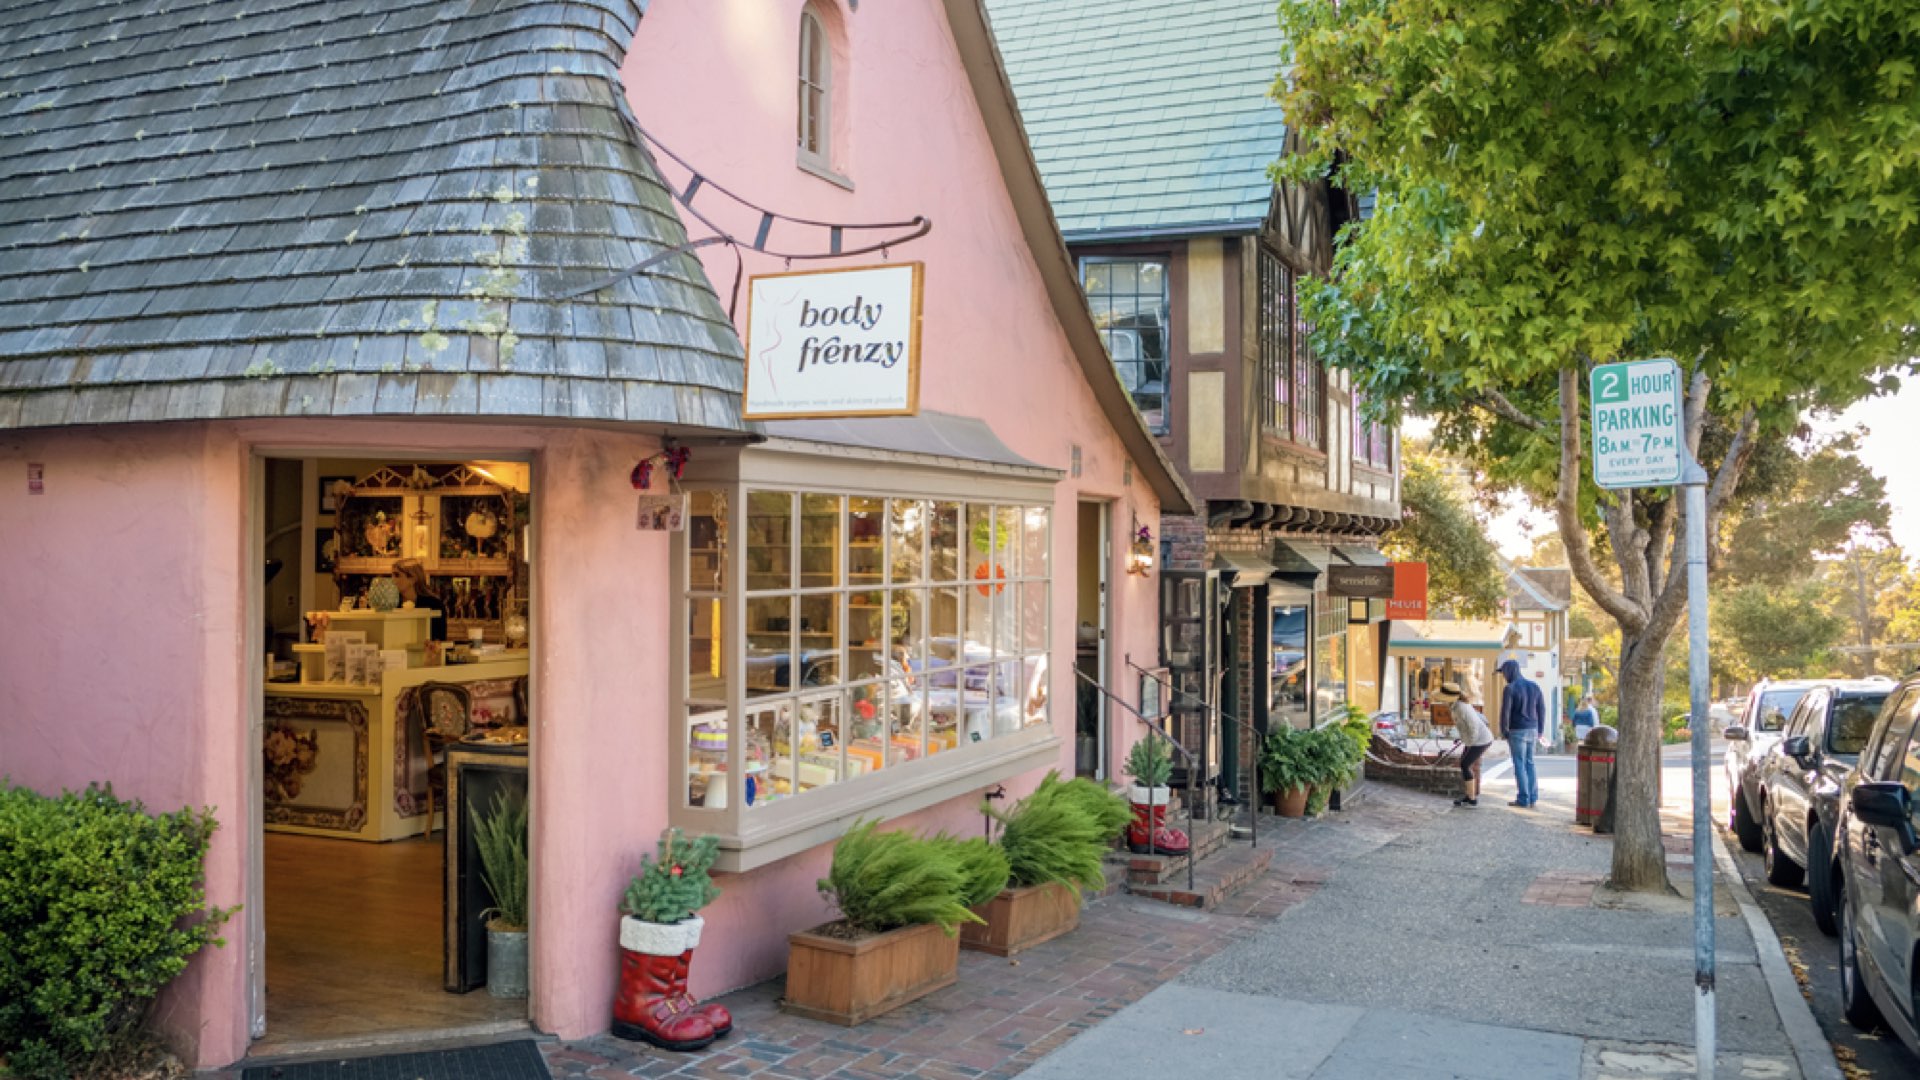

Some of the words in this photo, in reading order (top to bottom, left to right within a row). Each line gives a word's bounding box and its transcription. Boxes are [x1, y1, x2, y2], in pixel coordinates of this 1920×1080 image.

[800, 295, 882, 331] body
[797, 335, 903, 373] frenzy
[1601, 372, 1619, 398] 2
[1631, 374, 1672, 395] HOUR
[1598, 404, 1673, 432] PARKING
[1609, 457, 1640, 467] EVERY
[1645, 455, 1664, 464] DAY
